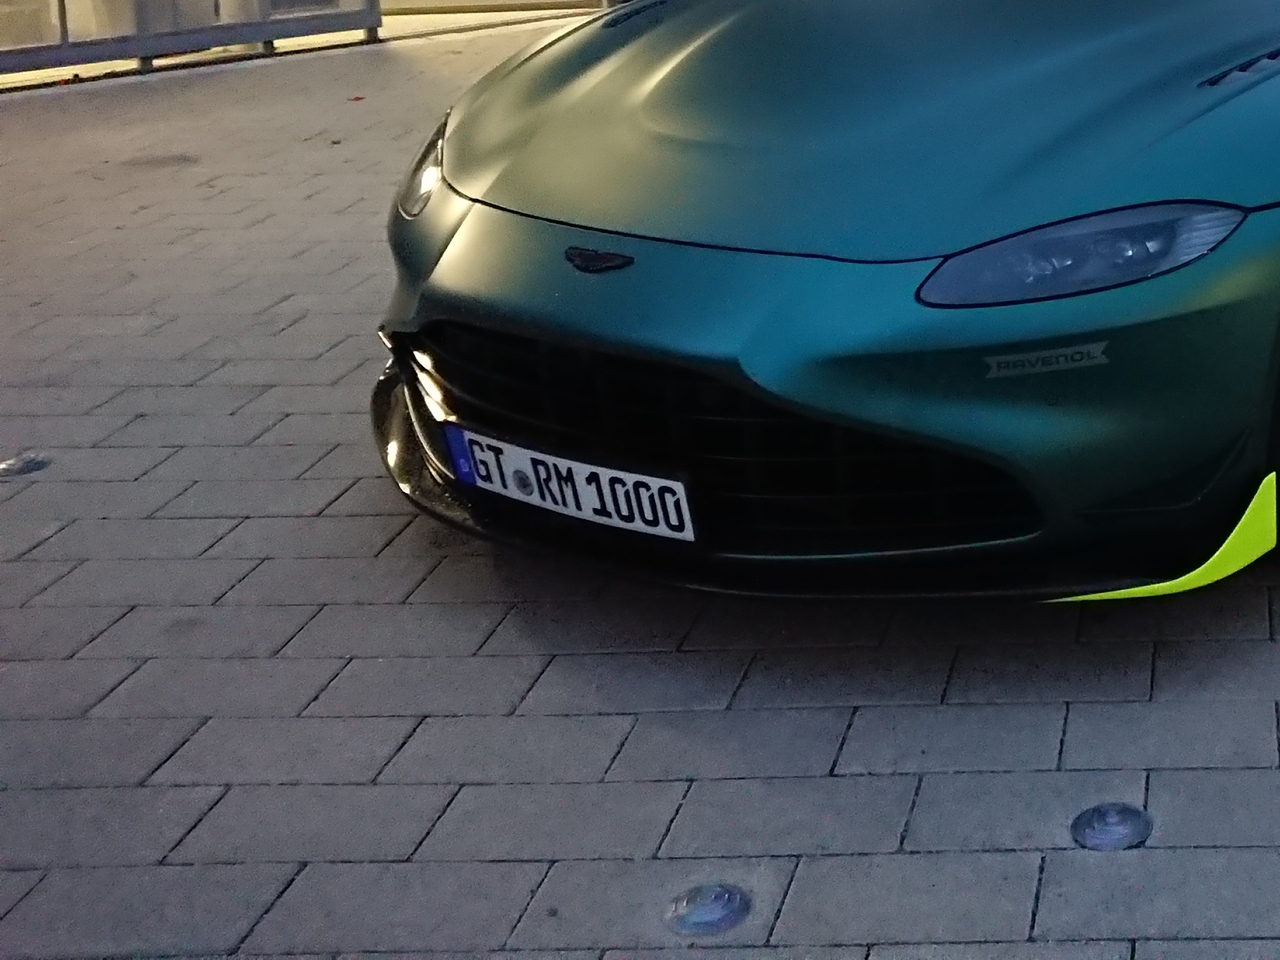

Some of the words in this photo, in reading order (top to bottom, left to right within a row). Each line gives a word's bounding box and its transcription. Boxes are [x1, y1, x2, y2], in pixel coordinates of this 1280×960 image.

[996, 350, 1099, 371] RAVENOL
[468, 438, 508, 489] GT
[530, 457, 582, 512] RM
[585, 471, 686, 533] 1000
